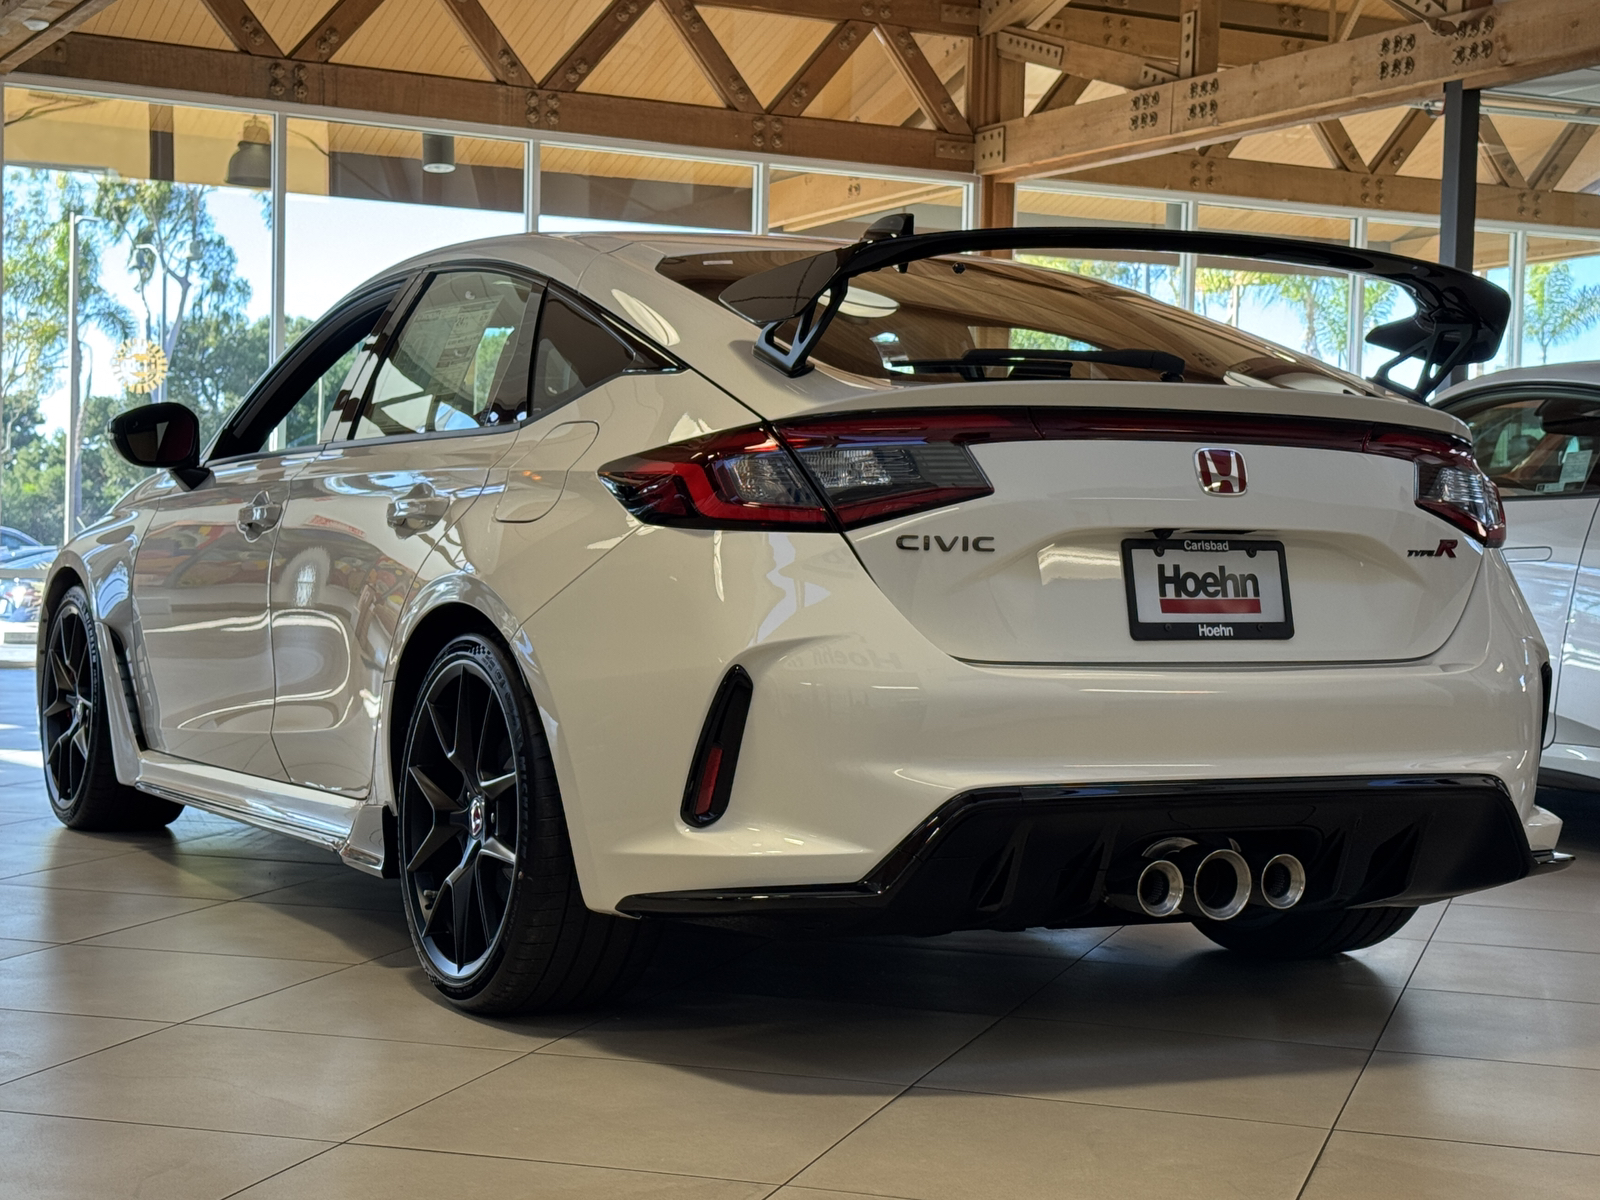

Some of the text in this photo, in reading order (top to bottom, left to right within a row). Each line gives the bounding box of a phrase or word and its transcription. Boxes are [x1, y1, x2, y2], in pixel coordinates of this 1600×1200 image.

[895, 534, 996, 553] CIVIC
[1183, 539, 1230, 552] Carlsbad
[1434, 538, 1459, 559] R
[1156, 563, 1261, 599] Hoehn
[1198, 623, 1234, 638] Hoehn
